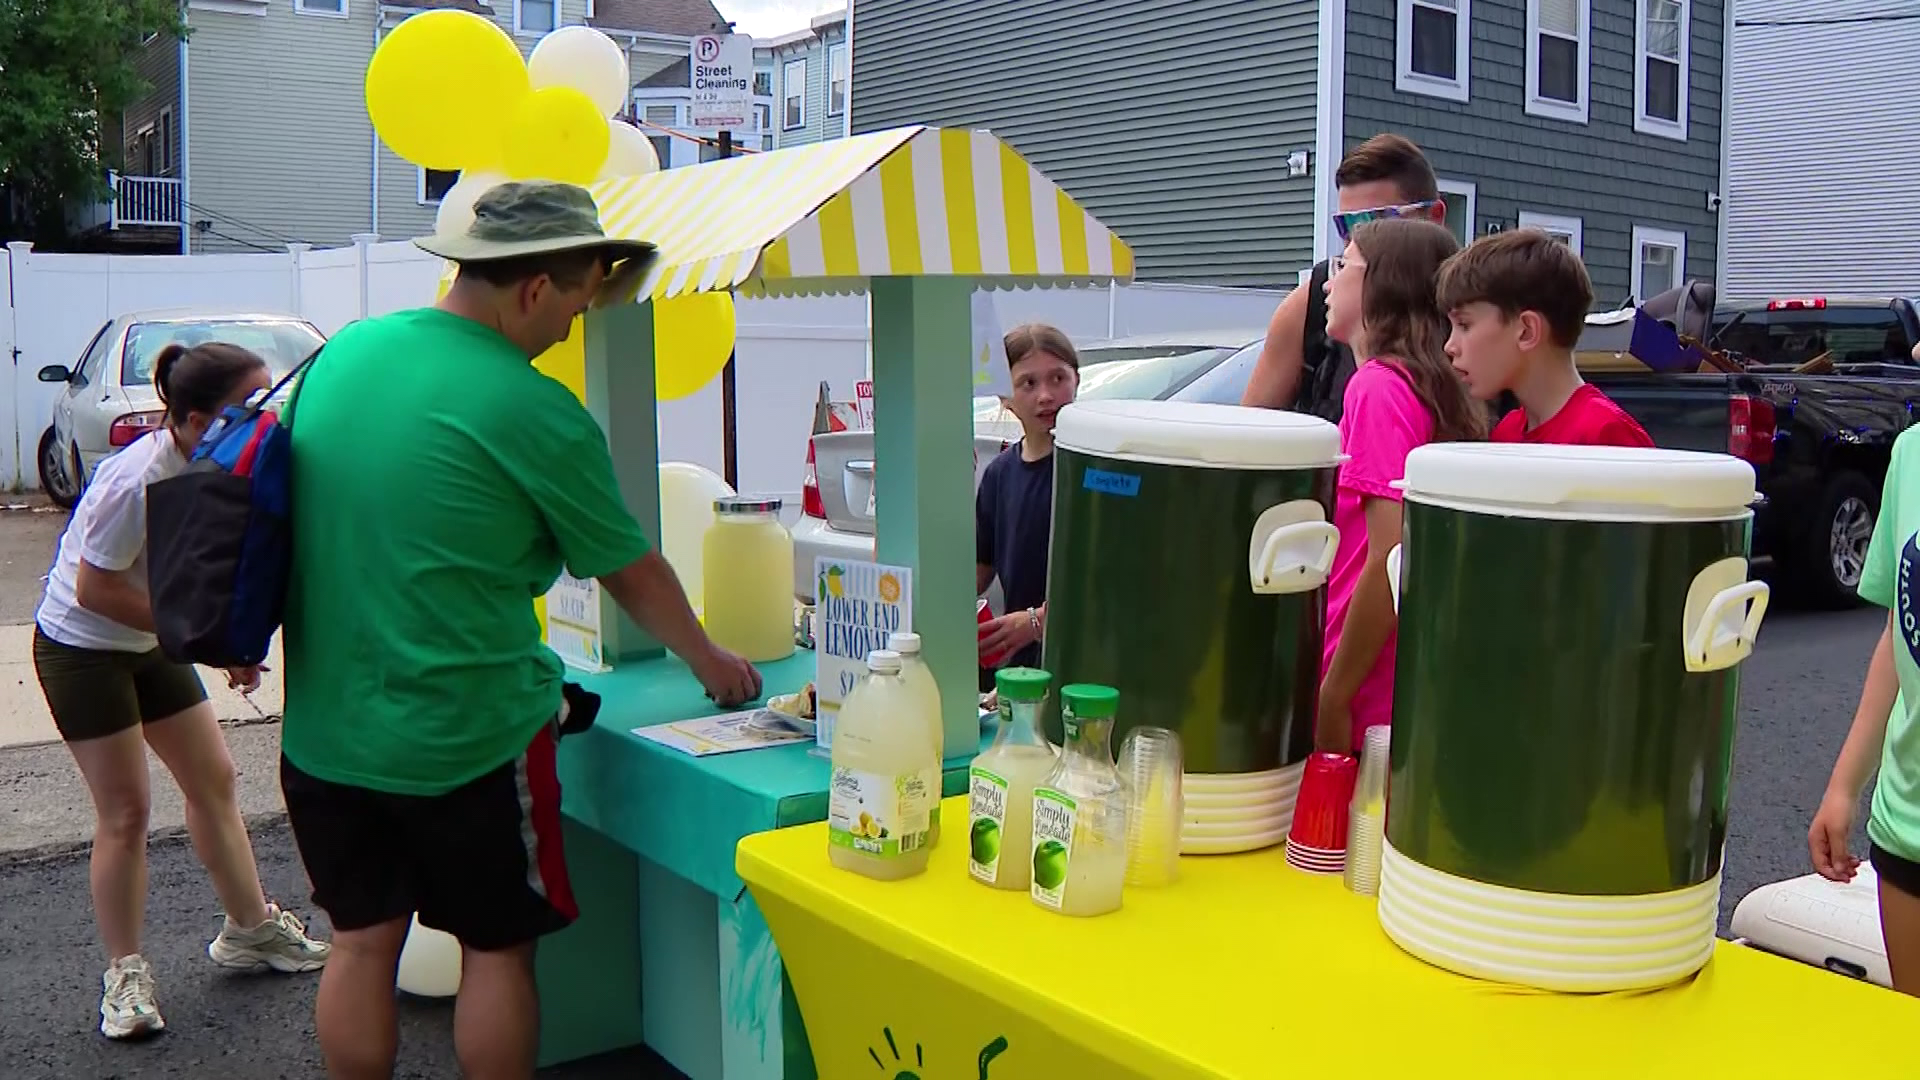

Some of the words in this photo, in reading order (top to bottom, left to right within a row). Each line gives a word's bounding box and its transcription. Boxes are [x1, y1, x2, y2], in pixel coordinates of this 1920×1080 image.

[696, 65, 732, 77] Street
[696, 78, 747, 90] Cleaning
[858, 384, 872, 397] TO
[825, 594, 869, 627] LOWER
[874, 601, 899, 631] END
[1901, 557, 1920, 648] SOUTH
[825, 621, 890, 662] LEMONAD
[972, 777, 1002, 806] Simply
[1036, 799, 1070, 829] Simply
